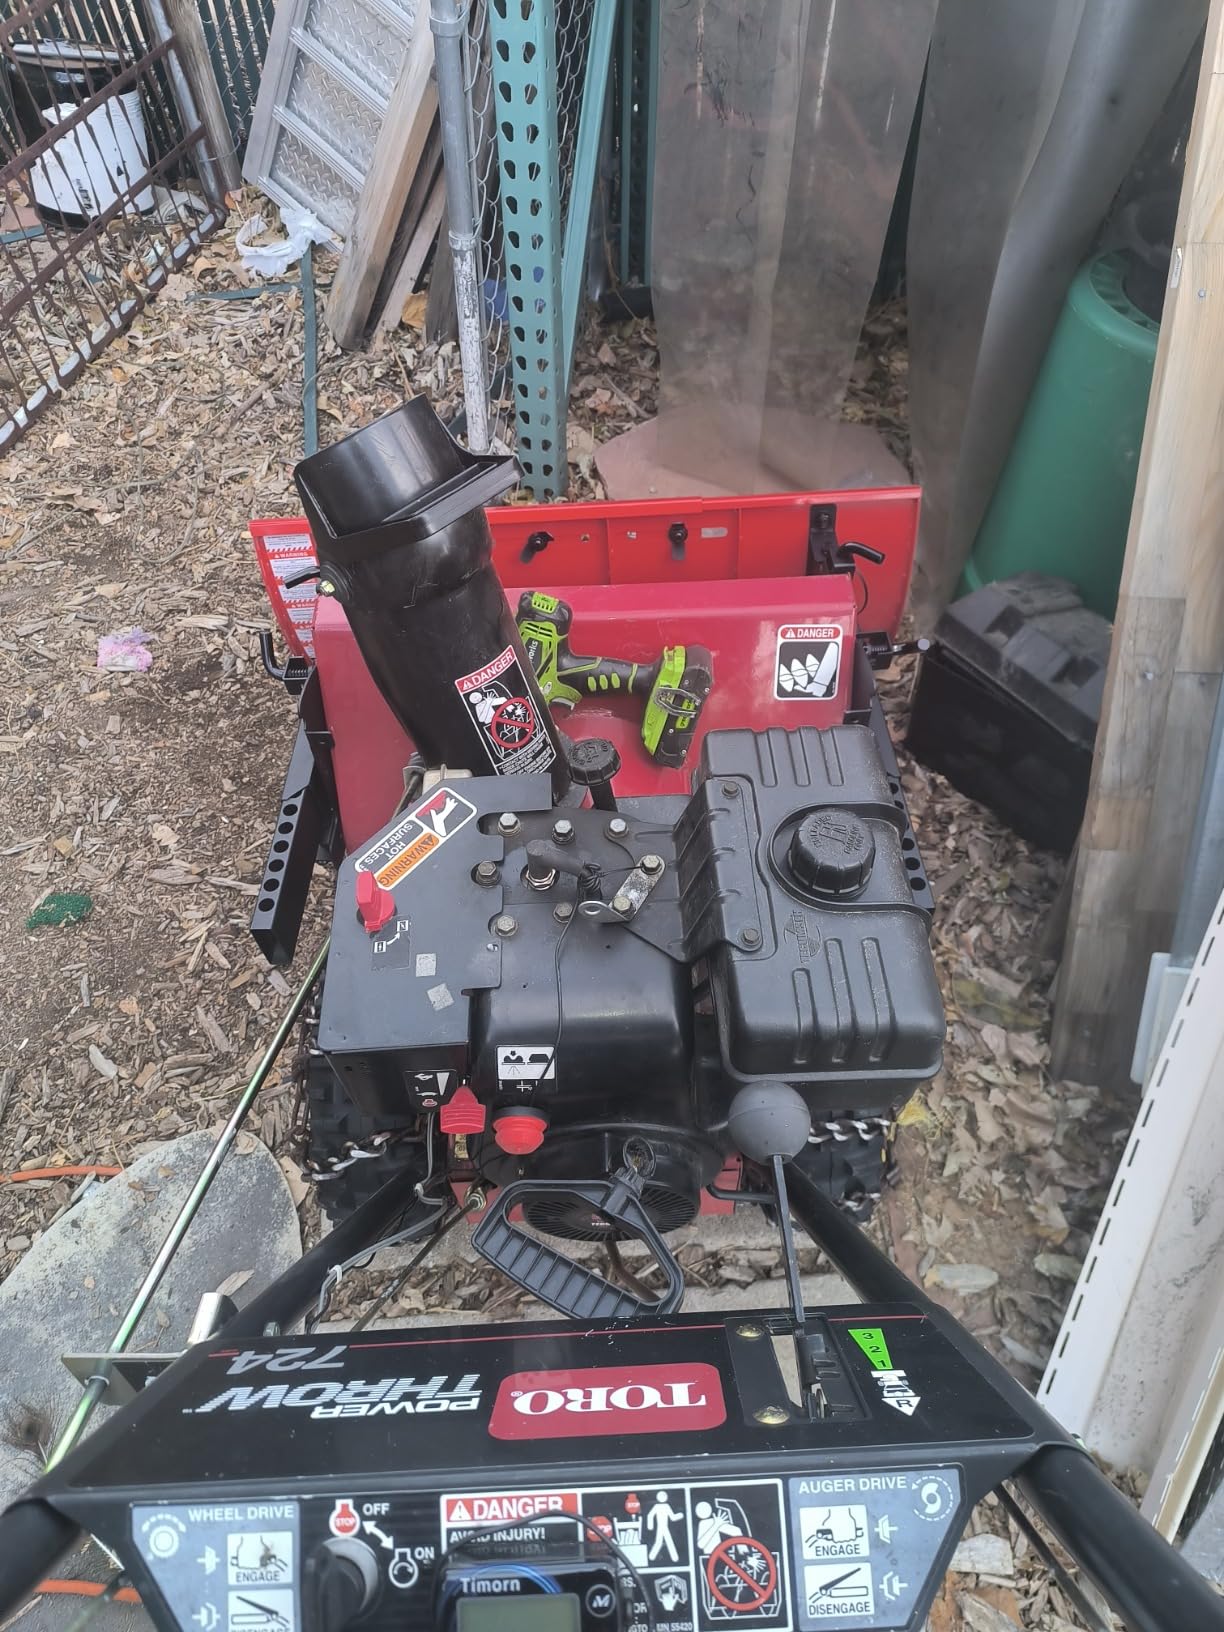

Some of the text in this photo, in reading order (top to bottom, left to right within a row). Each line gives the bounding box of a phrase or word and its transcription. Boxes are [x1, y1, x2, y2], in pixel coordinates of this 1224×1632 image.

[797, 628, 834, 638] DANGER
[471, 651, 513, 685] DANGER
[366, 823, 413, 865] SURFACES
[386, 840, 406, 860] HOT
[379, 843, 429, 887] WARNING
[862, 1332, 874, 1340] 3
[869, 1345, 882, 1353] 2
[226, 1345, 348, 1375] 724
[877, 1360, 887, 1368] 1
[195, 1374, 482, 1413] THROW
[310, 1397, 480, 1419] POWER
[895, 1399, 914, 1408] R
[799, 1476, 907, 1494] AUGER DRIVE
[188, 1505, 294, 1522] WHEEL DRIVE
[362, 1502, 390, 1516] OFF
[473, 1496, 563, 1520] DANGER
[335, 1517, 356, 1527] STOP
[494, 1527, 545, 1542] INJURY!
[414, 1546, 435, 1560] ON
[815, 1544, 861, 1557] ENGAGE
[235, 1571, 280, 1583] ENGAGE
[460, 1576, 521, 1594] Timorn
[809, 1601, 871, 1616] DISENGAGE
